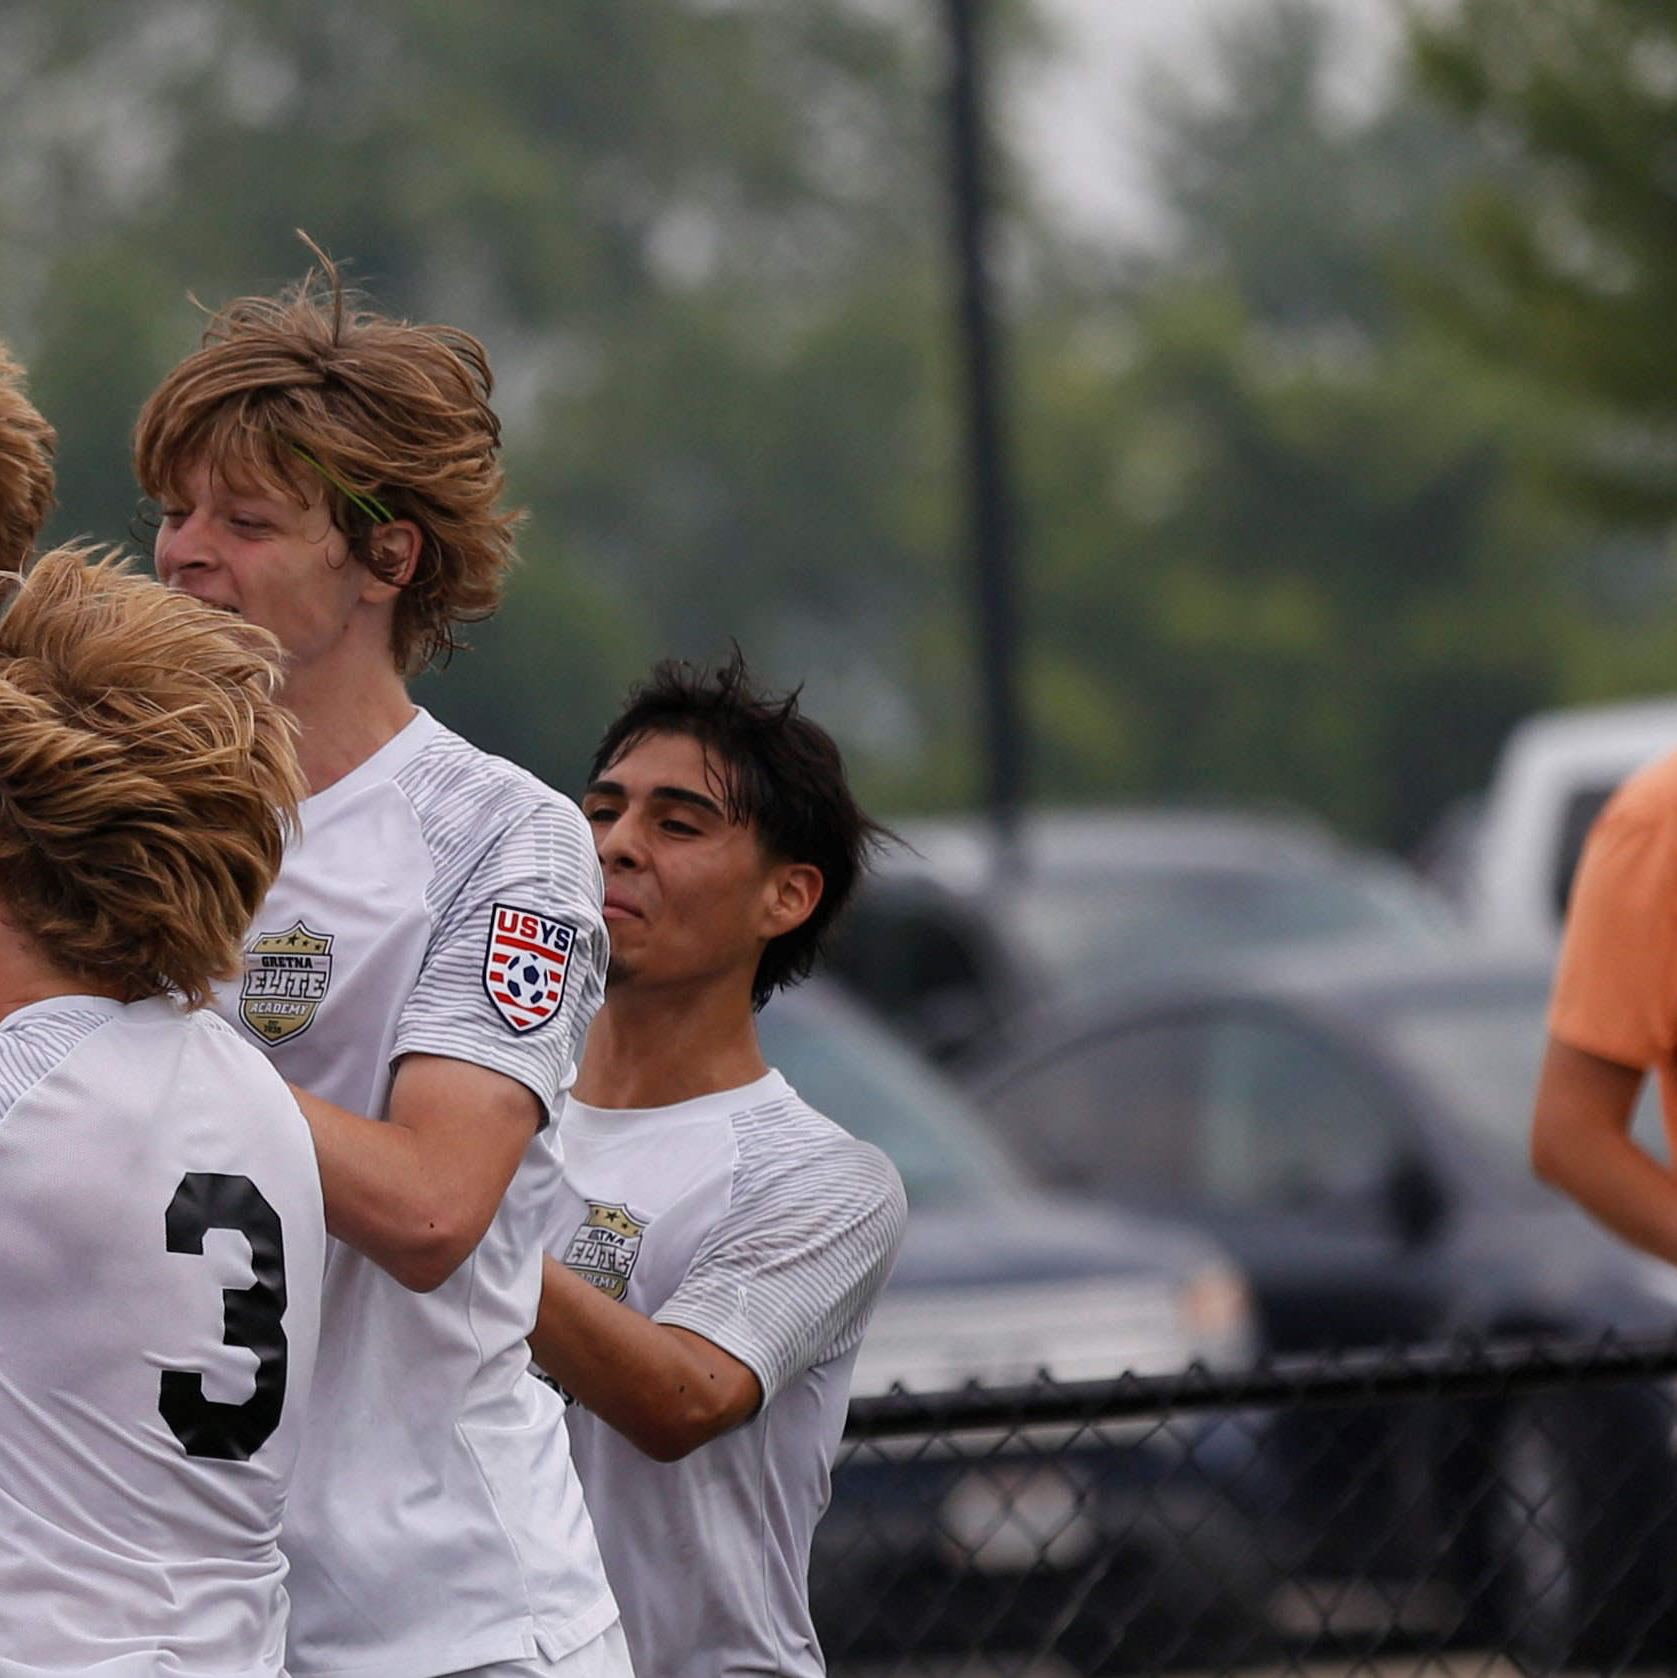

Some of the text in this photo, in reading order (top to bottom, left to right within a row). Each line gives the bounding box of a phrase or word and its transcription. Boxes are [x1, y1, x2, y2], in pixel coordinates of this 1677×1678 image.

[497, 910, 571, 952] USYS
[261, 956, 314, 969] GRETNA
[244, 969, 327, 999] ELITE
[249, 1002, 308, 1016] ACADEMY
[563, 1240, 635, 1275] ELITE
[158, 1172, 287, 1461] 3
